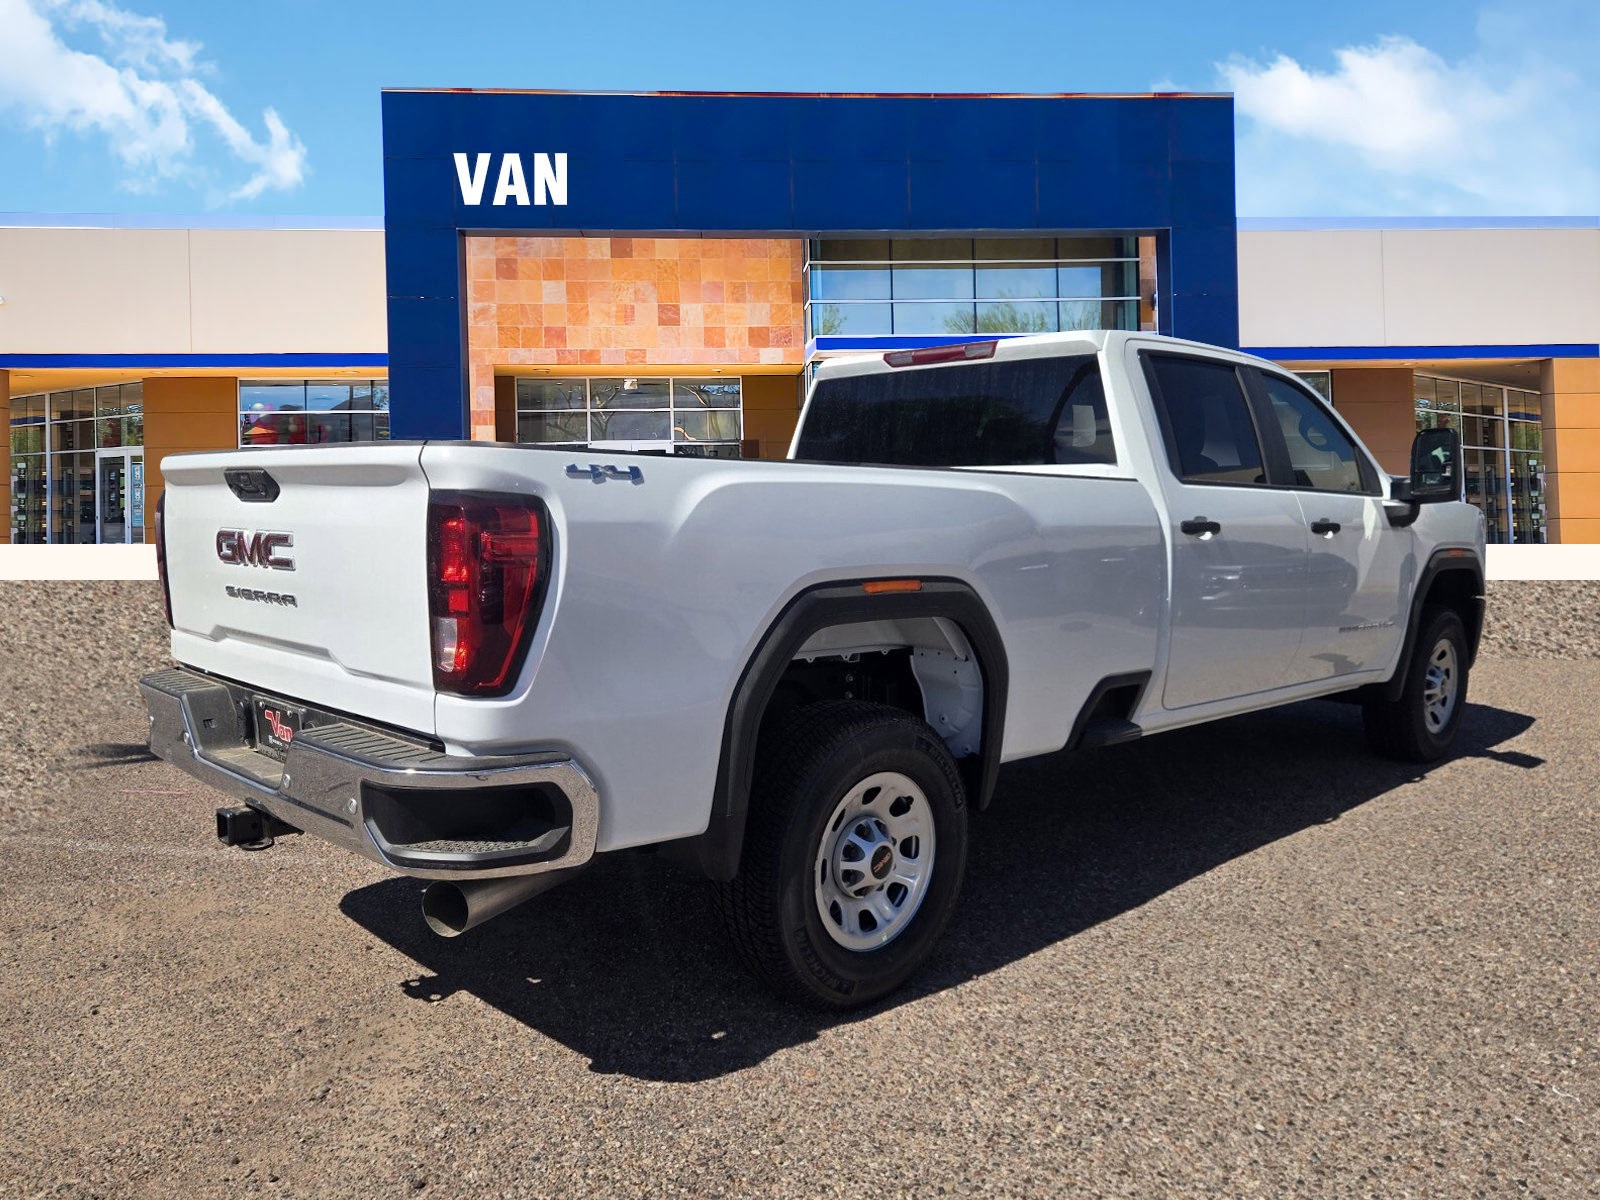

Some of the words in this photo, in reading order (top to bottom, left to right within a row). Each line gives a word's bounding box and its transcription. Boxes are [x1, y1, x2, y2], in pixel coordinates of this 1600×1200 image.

[453, 152, 568, 206] VAN
[216, 526, 296, 572] GMC
[225, 585, 298, 608] SIERRA
[264, 709, 293, 743] Van
